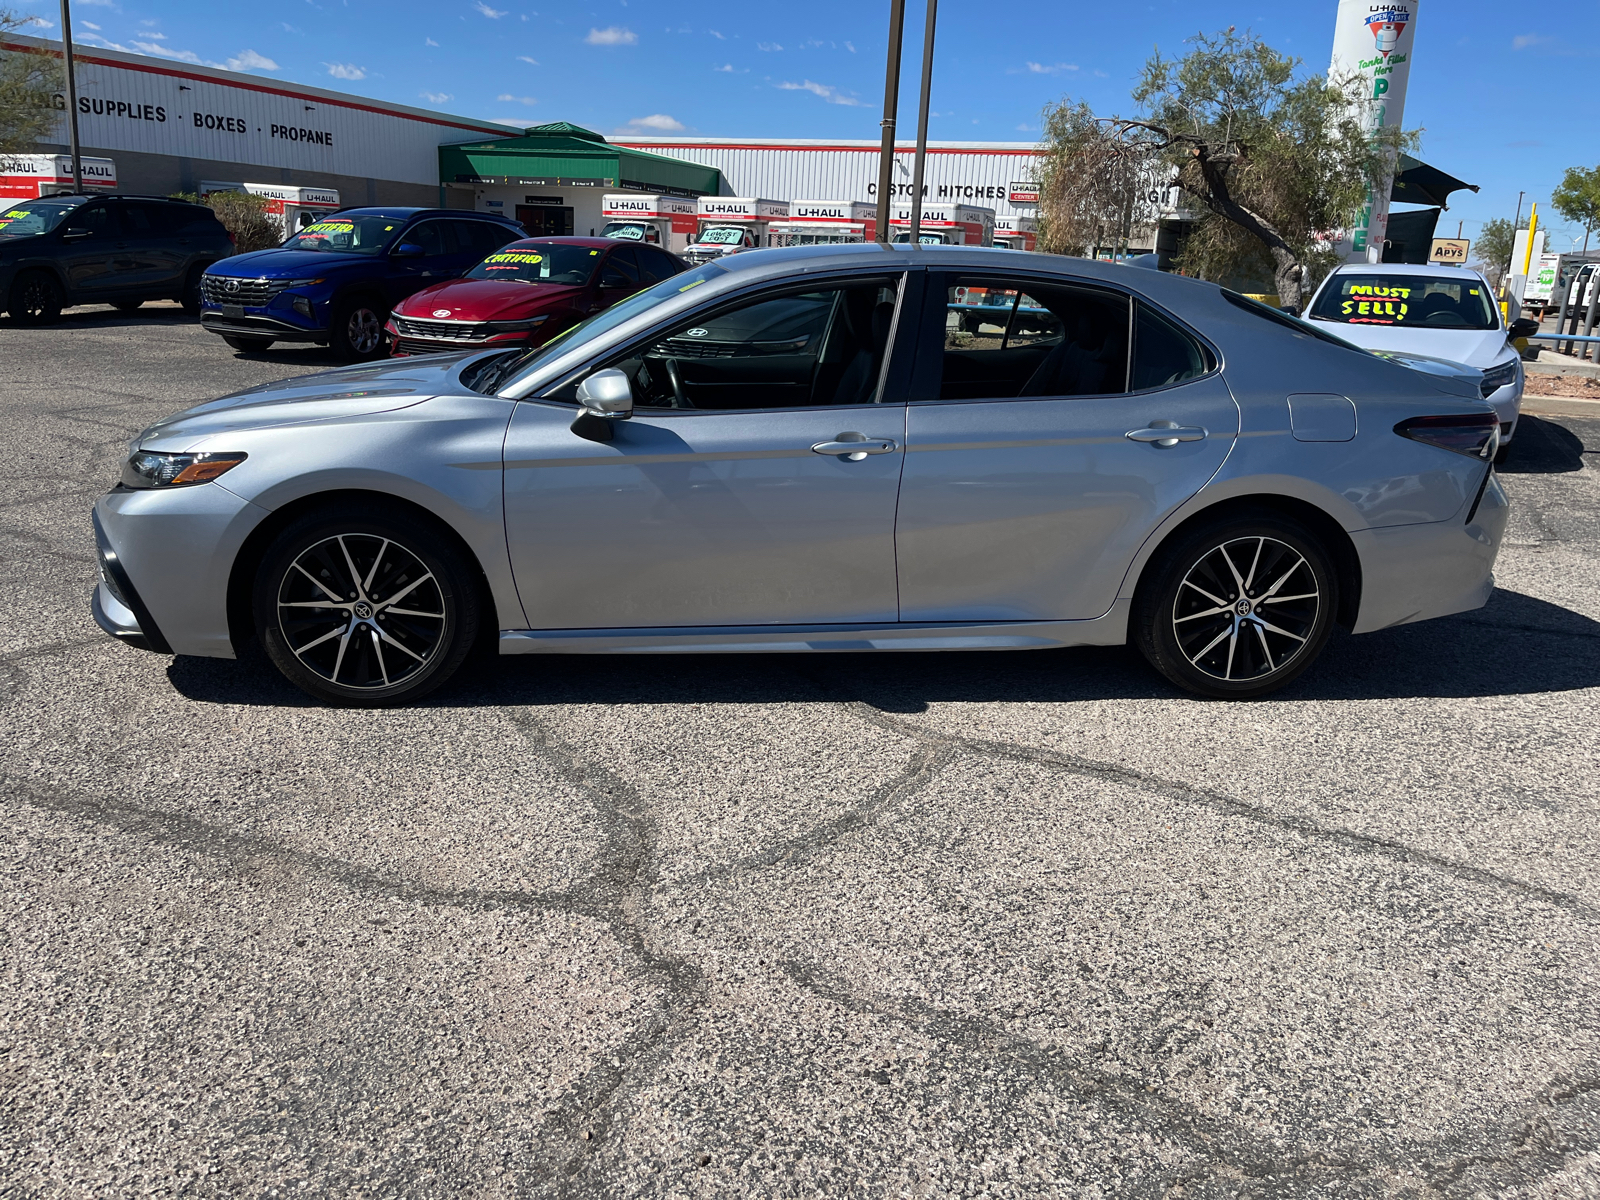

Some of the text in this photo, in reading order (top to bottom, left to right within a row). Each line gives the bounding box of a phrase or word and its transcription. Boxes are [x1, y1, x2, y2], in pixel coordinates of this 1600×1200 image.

[1369, 5, 1408, 13] U-HAUL
[1369, 12, 1387, 23] OPEN
[1394, 13, 1407, 21] DAYS
[1358, 53, 1407, 70] Tanks Filled
[1374, 65, 1393, 77] Here
[79, 96, 166, 123] SUPPLIES
[193, 112, 247, 134] BOXES
[270, 123, 333, 147] PROPANE
[62, 164, 113, 177] UHAUL
[255, 190, 286, 200] U-HAUL
[867, 182, 1006, 199] CSTOM HITCHES
[306, 194, 336, 203] U-HAUL
[609, 201, 651, 211] U-HAUL
[671, 204, 694, 214] U-HAUL
[705, 204, 749, 214] U-HAUL
[769, 206, 789, 217] U-HAUL
[797, 208, 845, 218] U-HAUL
[898, 211, 948, 221] UAUL
[302, 222, 355, 233] CERTIFIED
[484, 253, 543, 264] CERTIFIED
[1349, 285, 1411, 299] MUST
[1341, 300, 1408, 320] SELL!
